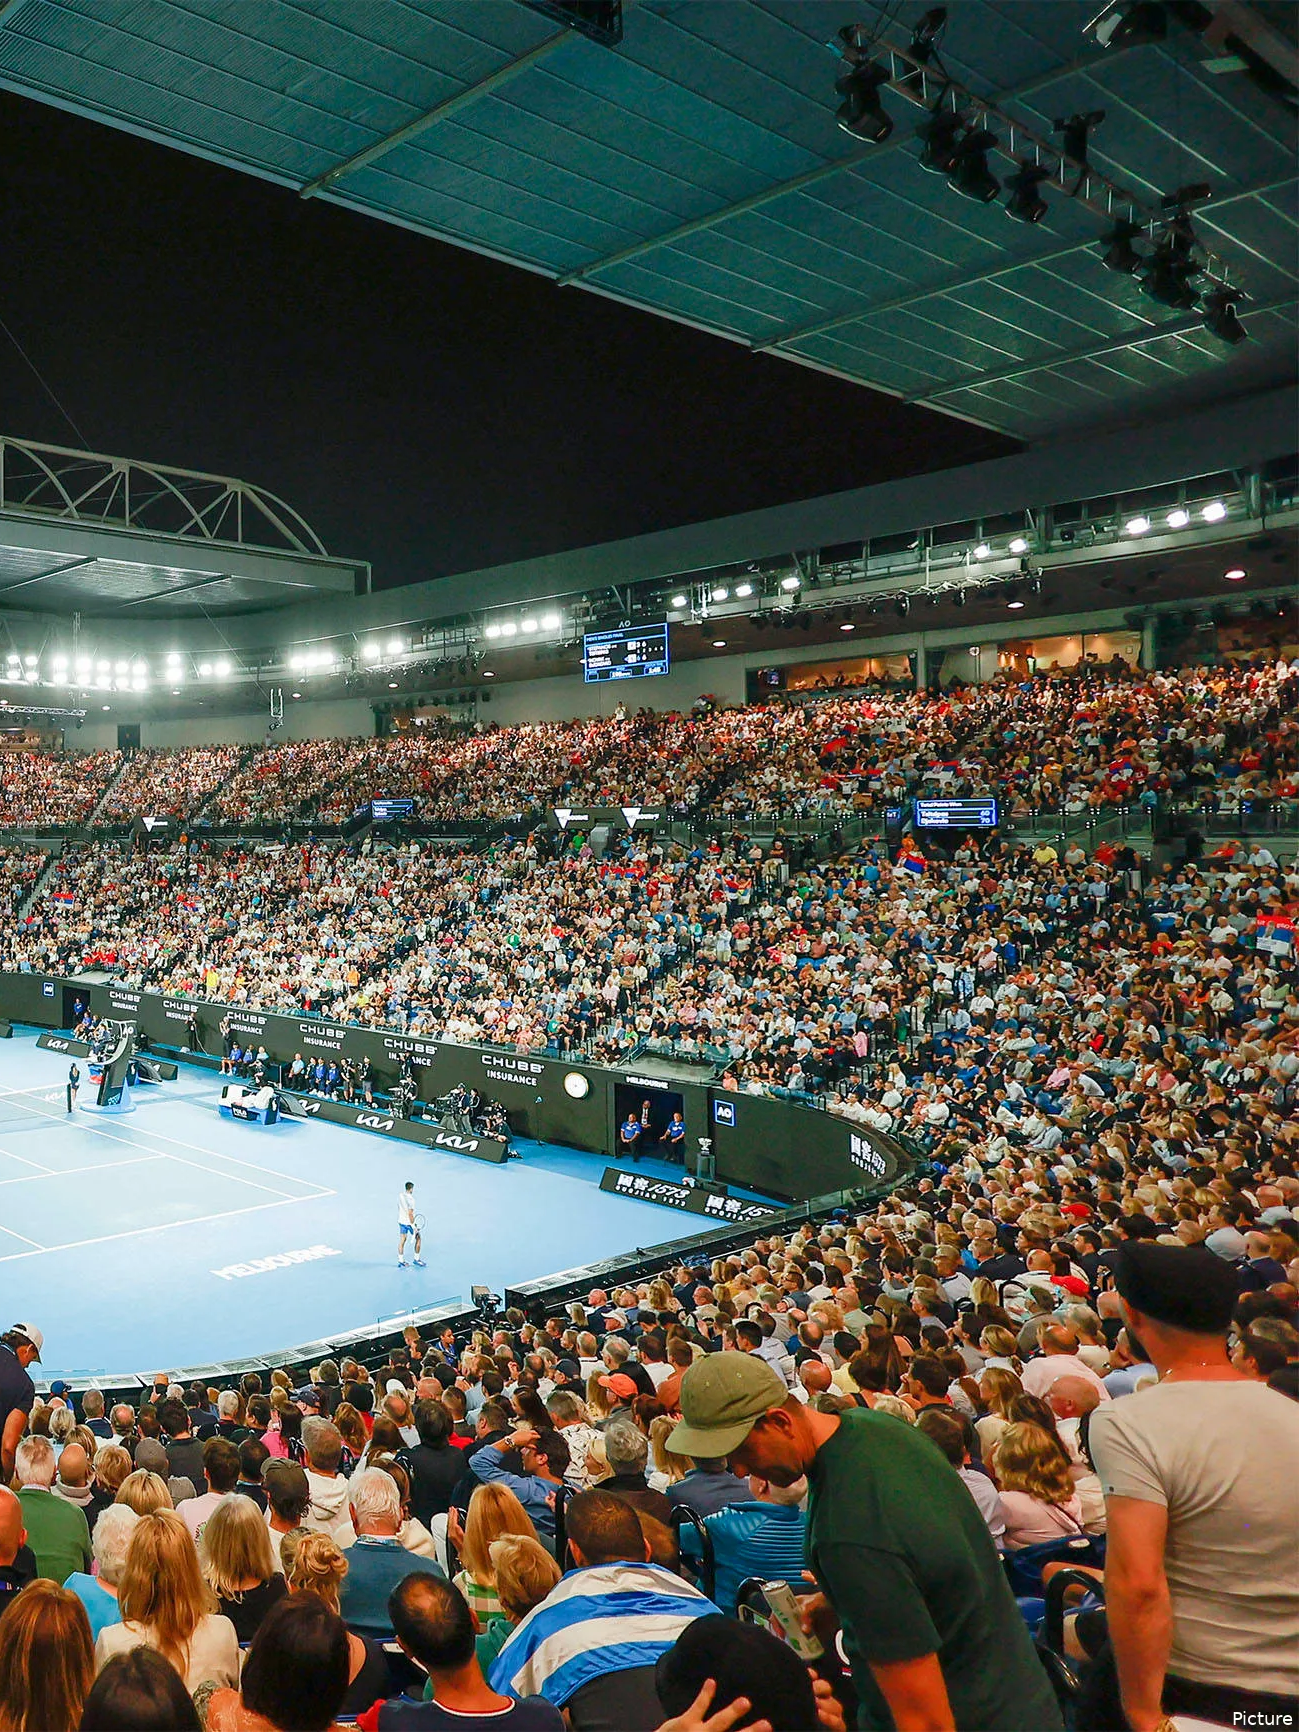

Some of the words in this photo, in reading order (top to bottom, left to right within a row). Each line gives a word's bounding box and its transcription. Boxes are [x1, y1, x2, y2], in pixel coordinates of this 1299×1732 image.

[109, 991, 141, 1002] CHUBB
[112, 1002, 138, 1011] INSURANCE
[163, 1000, 199, 1012] CHUBB
[227, 1012, 267, 1025] CHUBB
[230, 1023, 263, 1035] INSURANCE
[300, 1024, 346, 1038] CHUBB
[47, 1039, 69, 1050] KIA
[304, 1036, 341, 1050] INSURANCE
[384, 1038, 438, 1055] CHUBB
[482, 1055, 544, 1074] CHUBB
[487, 1069, 537, 1086] INSURANCE
[626, 1076, 669, 1089] MELBOURNE
[717, 1106, 732, 1119] AO
[356, 1113, 395, 1131] KIA
[436, 1132, 479, 1151] KIA
[209, 1244, 343, 1281] MELBOURNE
